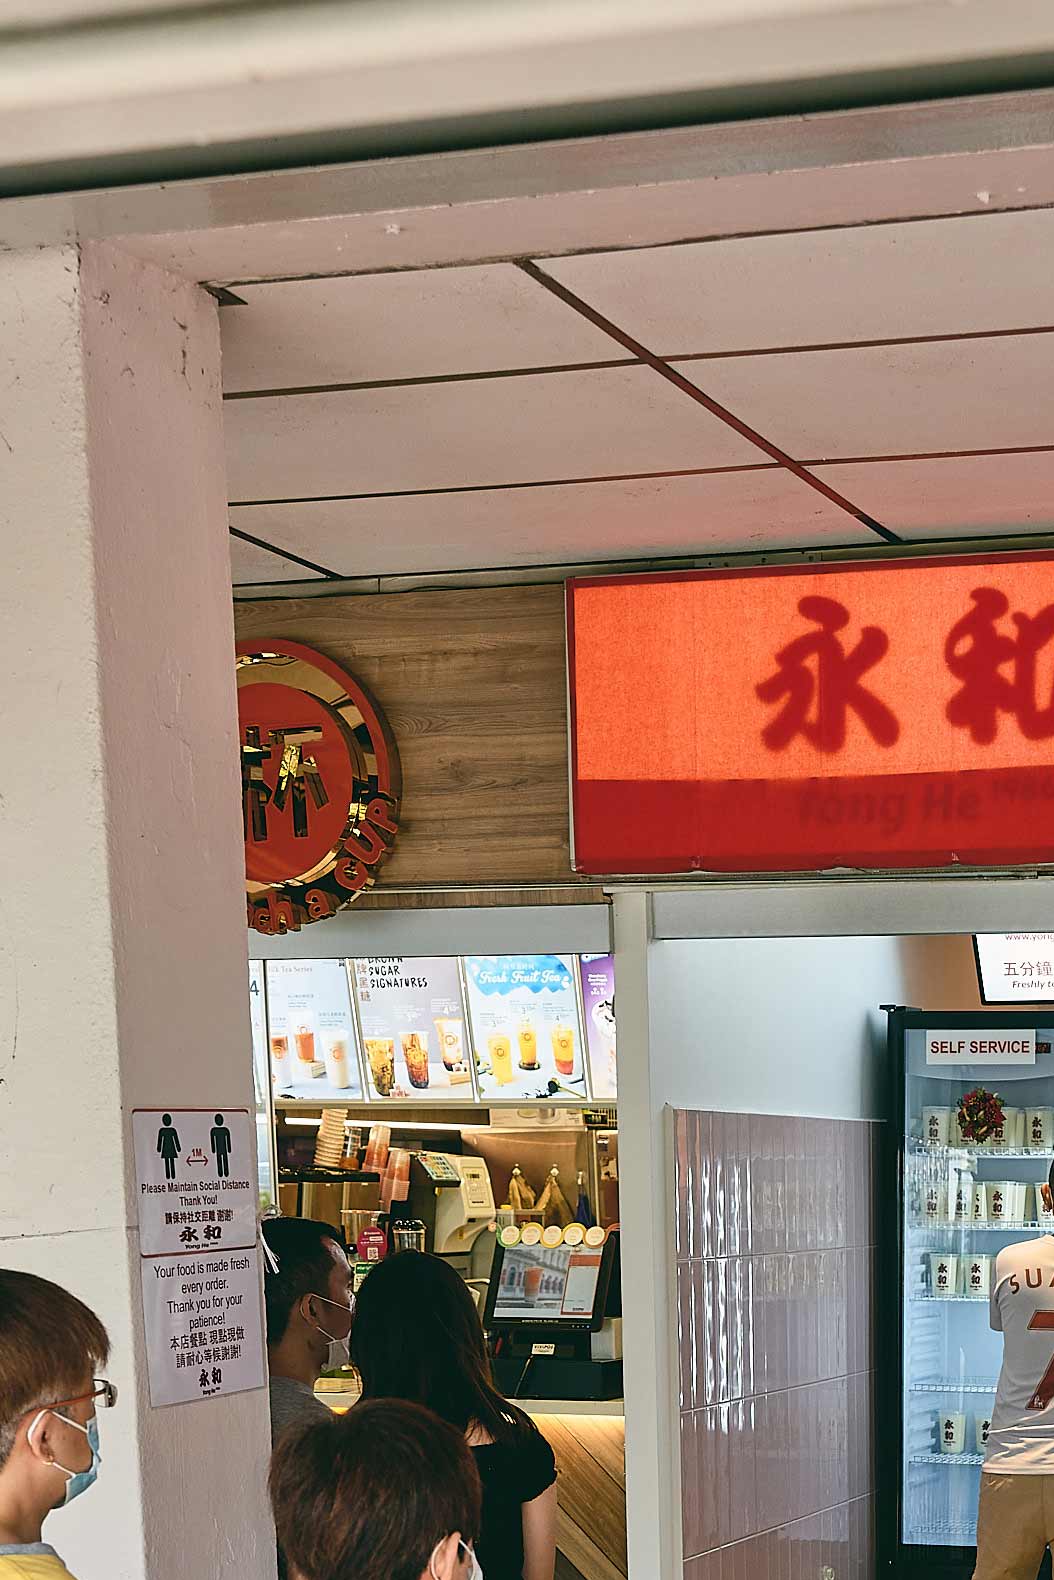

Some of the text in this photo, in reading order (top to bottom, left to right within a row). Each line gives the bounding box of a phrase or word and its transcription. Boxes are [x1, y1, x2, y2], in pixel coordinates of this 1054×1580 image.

[368, 966, 401, 976] SUGAR
[480, 969, 562, 984] Fresh Fruit Tea
[1004, 961, 1053, 977] 五分鐘
[370, 977, 428, 989] SIGNATURES
[1012, 979, 1045, 990] Freshly
[930, 1040, 1030, 1054] SELF SERVICE
[191, 1148, 203, 1157] 1M
[141, 1179, 250, 1194] Please Maintain Social Distance
[179, 1194, 218, 1206] Thank You!
[179, 1225, 222, 1242] 永和
[154, 1256, 250, 1279] Your food is made fresh
[181, 1277, 229, 1295] every order.
[167, 1294, 243, 1314] Thank you for your
[189, 1311, 226, 1332] patience!
[170, 1325, 245, 1351] 本店餐點 現點現做
[199, 1366, 222, 1388] 永和
